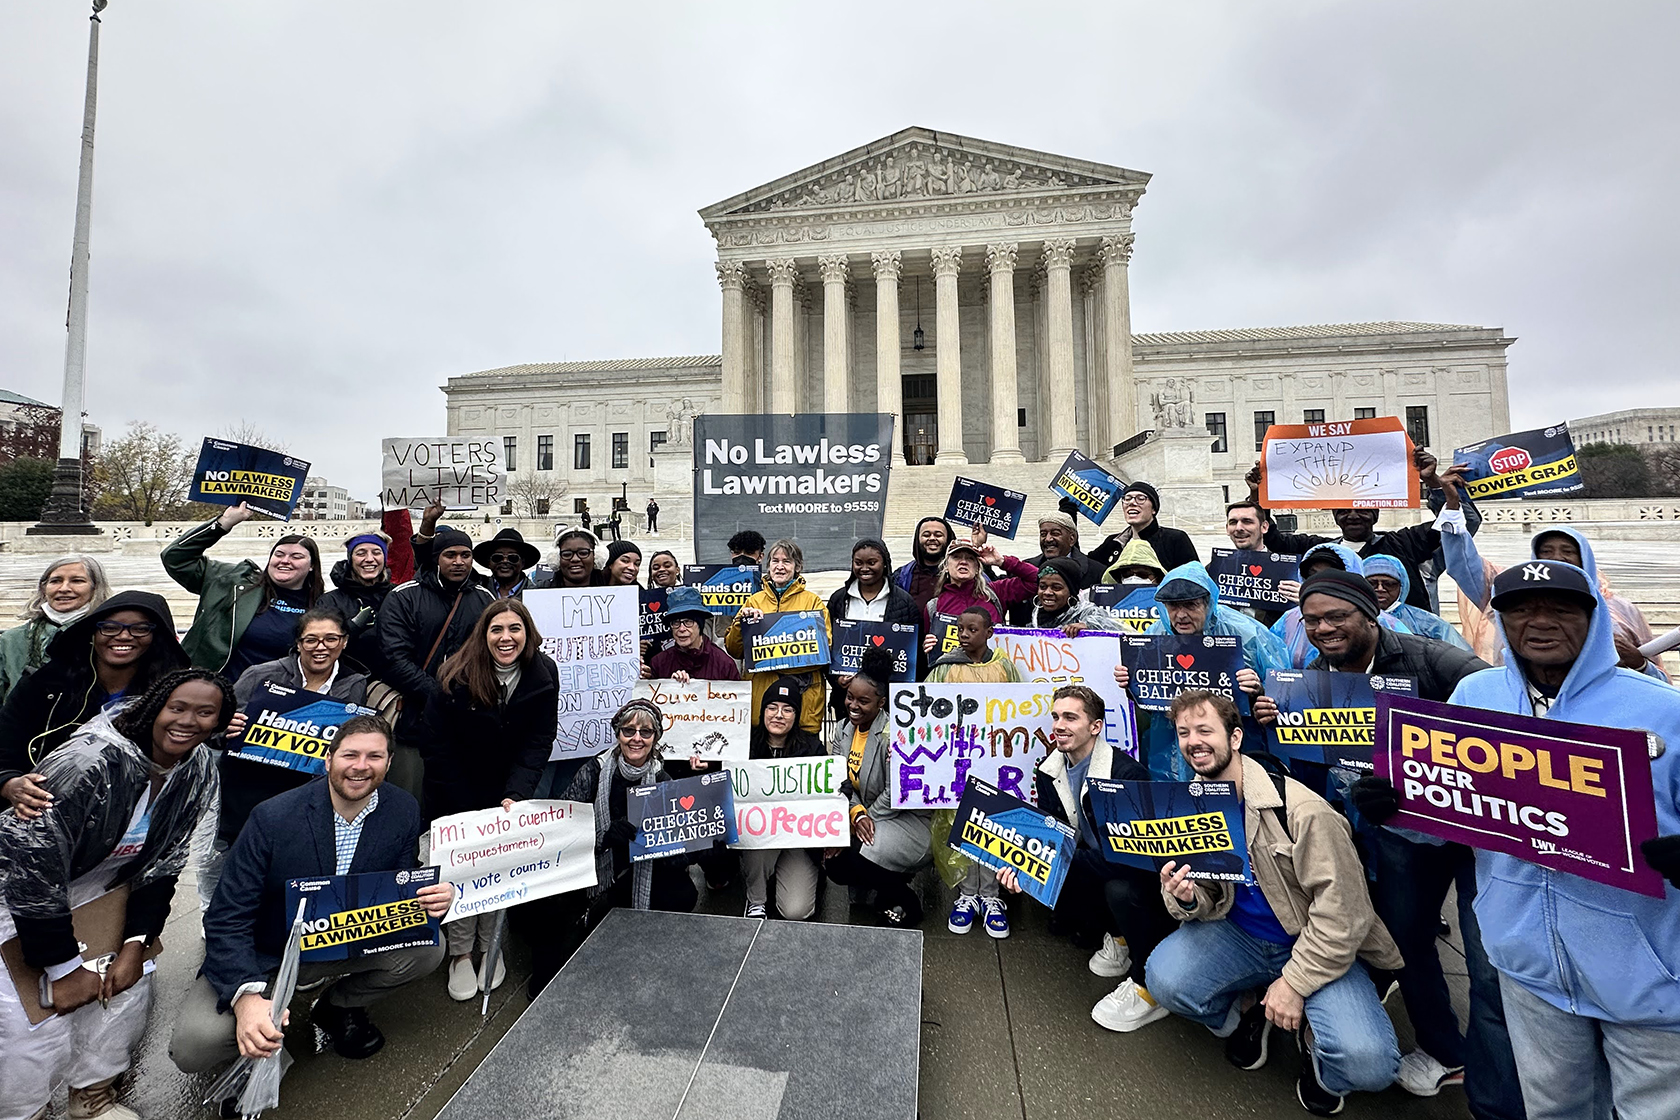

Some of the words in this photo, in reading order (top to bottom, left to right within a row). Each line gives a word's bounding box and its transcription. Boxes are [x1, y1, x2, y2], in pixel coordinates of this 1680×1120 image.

[839, 226, 875, 237] EQUAL
[879, 223, 923, 233] JUSTICE
[929, 219, 967, 229] UNDER
[972, 217, 995, 227] LAW
[1308, 425, 1328, 437] WE
[1328, 423, 1352, 436] SAY
[391, 441, 496, 466] VOTERS
[705, 438, 749, 465] No
[755, 438, 881, 465] Lawless
[1274, 441, 1355, 456] EXPAND
[1295, 455, 1342, 468] THE
[1493, 453, 1526, 470] STOP
[205, 471, 229, 481] NO
[232, 472, 293, 489] LAWLESS
[409, 463, 498, 487] LIVES
[703, 468, 881, 495] Lawmakers
[1065, 467, 1091, 490] Hands
[1090, 487, 1110, 502] Off
[1467, 473, 1529, 496] POWER
[1530, 459, 1576, 481] GRAB
[204, 483, 291, 499] LAWMAKERS
[386, 486, 498, 506] MATTER
[978, 495, 985, 504] I
[1059, 476, 1074, 490] MY
[1072, 486, 1102, 512] VOTE
[758, 503, 783, 513] Text
[784, 503, 829, 513] MOORE
[831, 504, 842, 513] to
[844, 501, 879, 513] 95559
[957, 500, 1001, 518] CHECKS
[1003, 512, 1012, 522] &
[1352, 500, 1408, 508] CPDACTION.ORG
[955, 508, 1011, 531] BALANCES
[1241, 564, 1248, 576] I
[1522, 563, 1551, 581] NY
[692, 582, 730, 593] Hands
[732, 582, 752, 593] Off
[1218, 574, 1272, 590] CHECKS
[1219, 585, 1288, 603] BALANCES
[562, 595, 615, 628] MY
[641, 603, 648, 614] I
[540, 631, 633, 663] FUTURE
[752, 632, 794, 647] Hands
[796, 629, 816, 641] Off
[864, 635, 871, 646] I
[754, 646, 776, 659] MY
[779, 642, 818, 656] VOTE
[898, 650, 907, 661] &
[1165, 654, 1175, 669] I
[558, 657, 641, 693] EPENDS
[1136, 669, 1210, 686] CHECKS
[1218, 672, 1232, 687] &
[592, 689, 627, 710] MY
[707, 682, 737, 700] been
[894, 685, 979, 738] Stop
[1277, 712, 1304, 726] NO
[1306, 711, 1376, 725] LAWLE
[257, 709, 319, 736] Hands
[250, 727, 287, 747] MY
[290, 736, 331, 758] VOT
[556, 718, 613, 752] VOT
[1280, 728, 1376, 742] LAWMAKE
[1401, 724, 1607, 798] PEOPLE
[761, 758, 834, 796] JUSTICE
[1403, 760, 1476, 791] OVER
[670, 798, 678, 813] I
[1403, 778, 1569, 837] POLITICS
[477, 816, 511, 836] voto
[642, 808, 708, 832] CHECKS
[713, 805, 724, 819] &
[770, 806, 844, 838] Peace
[1106, 822, 1132, 836] NO
[1134, 815, 1223, 836] LAWLESS
[644, 820, 726, 848] BALANCES
[969, 807, 1025, 847] Hands
[1026, 838, 1057, 865] Off
[1113, 833, 1230, 853] LAWMAKERS
[450, 832, 545, 867] (supuestamente)
[964, 824, 996, 849] MY
[1000, 842, 1049, 882] VOTE
[1531, 837, 1556, 852] LWV
[472, 872, 501, 890] vote
[301, 918, 330, 935] NO
[332, 900, 422, 928] LAWLESS
[303, 913, 425, 948] LAWMAKERS
[377, 943, 404, 952] MOORE
